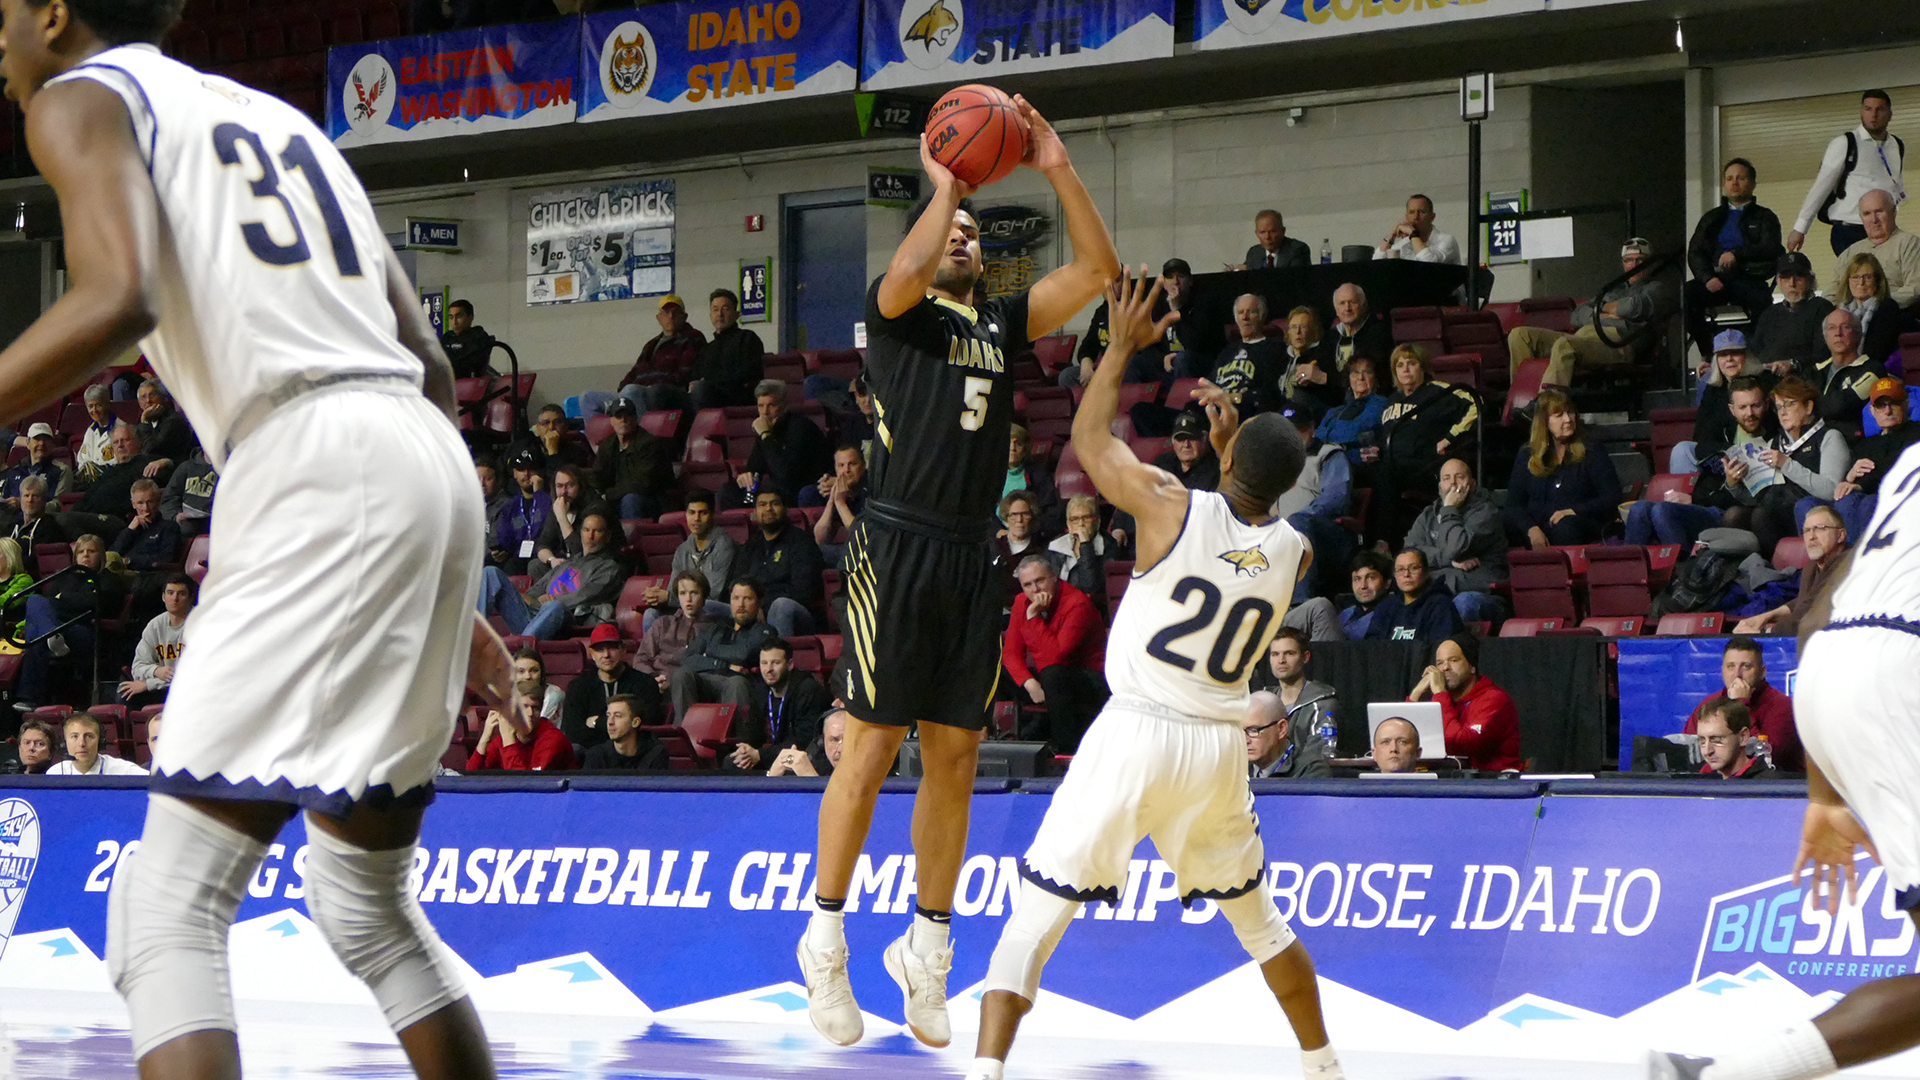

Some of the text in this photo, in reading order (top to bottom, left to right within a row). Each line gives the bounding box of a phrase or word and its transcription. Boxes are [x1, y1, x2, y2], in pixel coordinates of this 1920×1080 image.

[688, 0, 801, 51] IDAHO
[973, 17, 1082, 65] STATE
[400, 45, 514, 85] EASTERN
[686, 53, 797, 102] STATE
[400, 77, 572, 124] WASHINGTON
[884, 108, 911, 124] 112
[212, 122, 364, 278] 31
[878, 189, 912, 199] WOMEN
[430, 228, 455, 240] MEN
[979, 216, 1043, 236] LIGHT
[1494, 231, 1516, 246] 211
[592, 231, 625, 266] $5
[948, 335, 1005, 373] IDAHO
[960, 375, 994, 432] 5
[1145, 575, 1275, 685] 20
[1450, 864, 1662, 936] IDAHO
[1788, 961, 1907, 978] CONFERENCE
